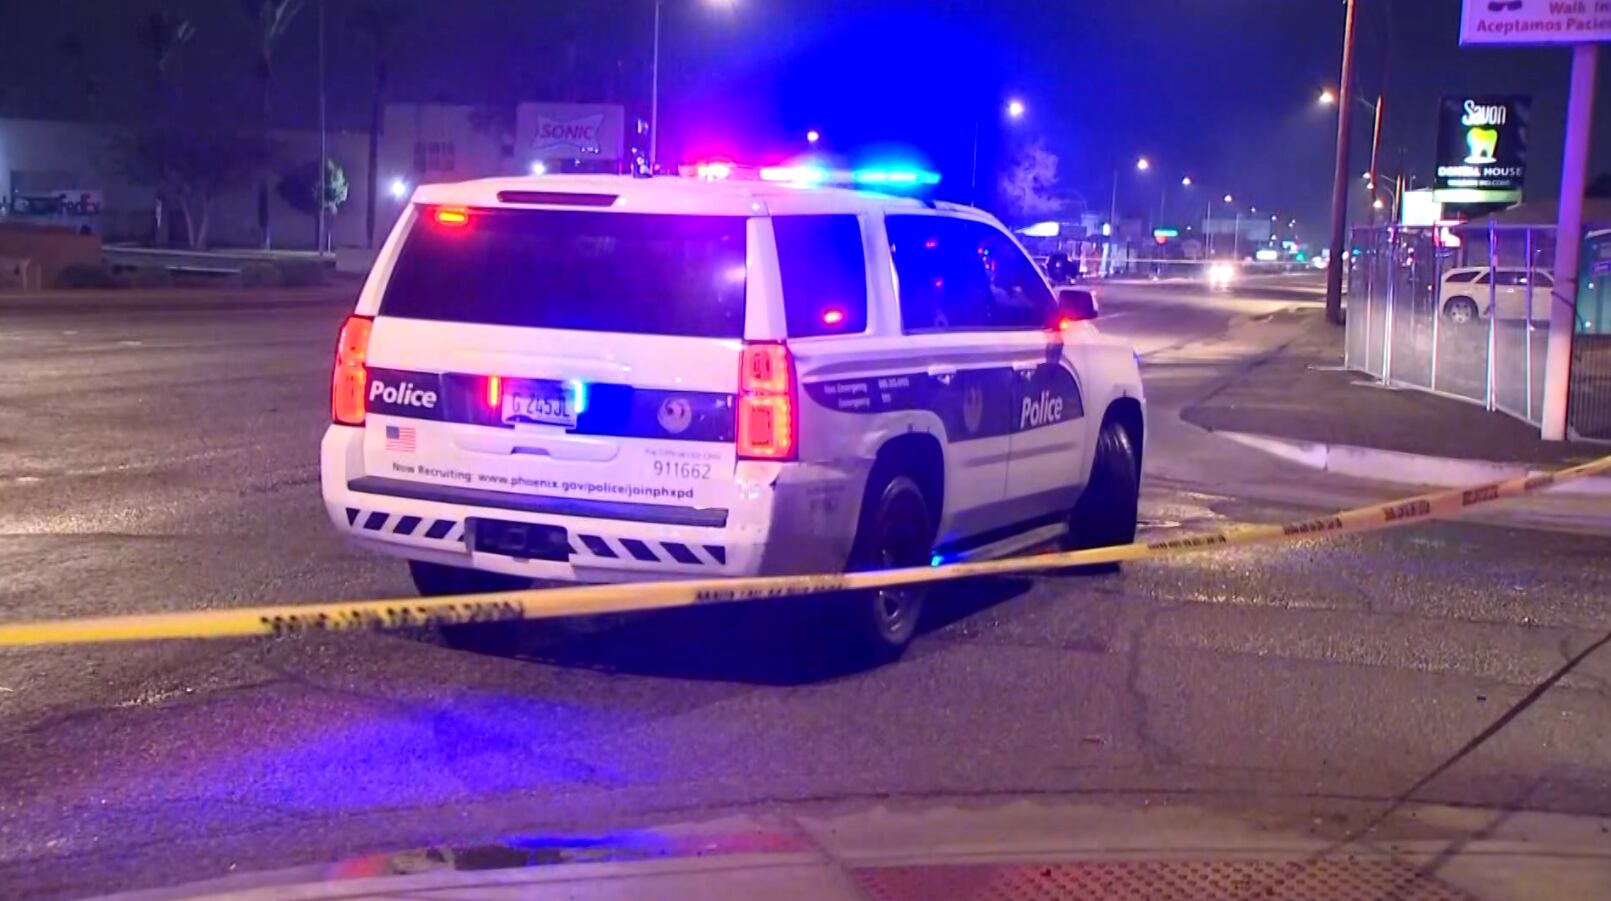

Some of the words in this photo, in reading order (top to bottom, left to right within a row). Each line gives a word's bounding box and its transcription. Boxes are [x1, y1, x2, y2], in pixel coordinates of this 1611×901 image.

[1549, 0, 1586, 14] Walk
[1476, 18, 1562, 35] Aceptamos
[1462, 99, 1507, 126] Savon
[540, 124, 594, 140] SONIC
[1483, 167, 1521, 177] HOUSE
[369, 380, 438, 409] Police
[1020, 390, 1063, 430] Police
[392, 462, 415, 473] Now
[418, 465, 473, 482] Recruiting
[653, 459, 712, 480] 911662
